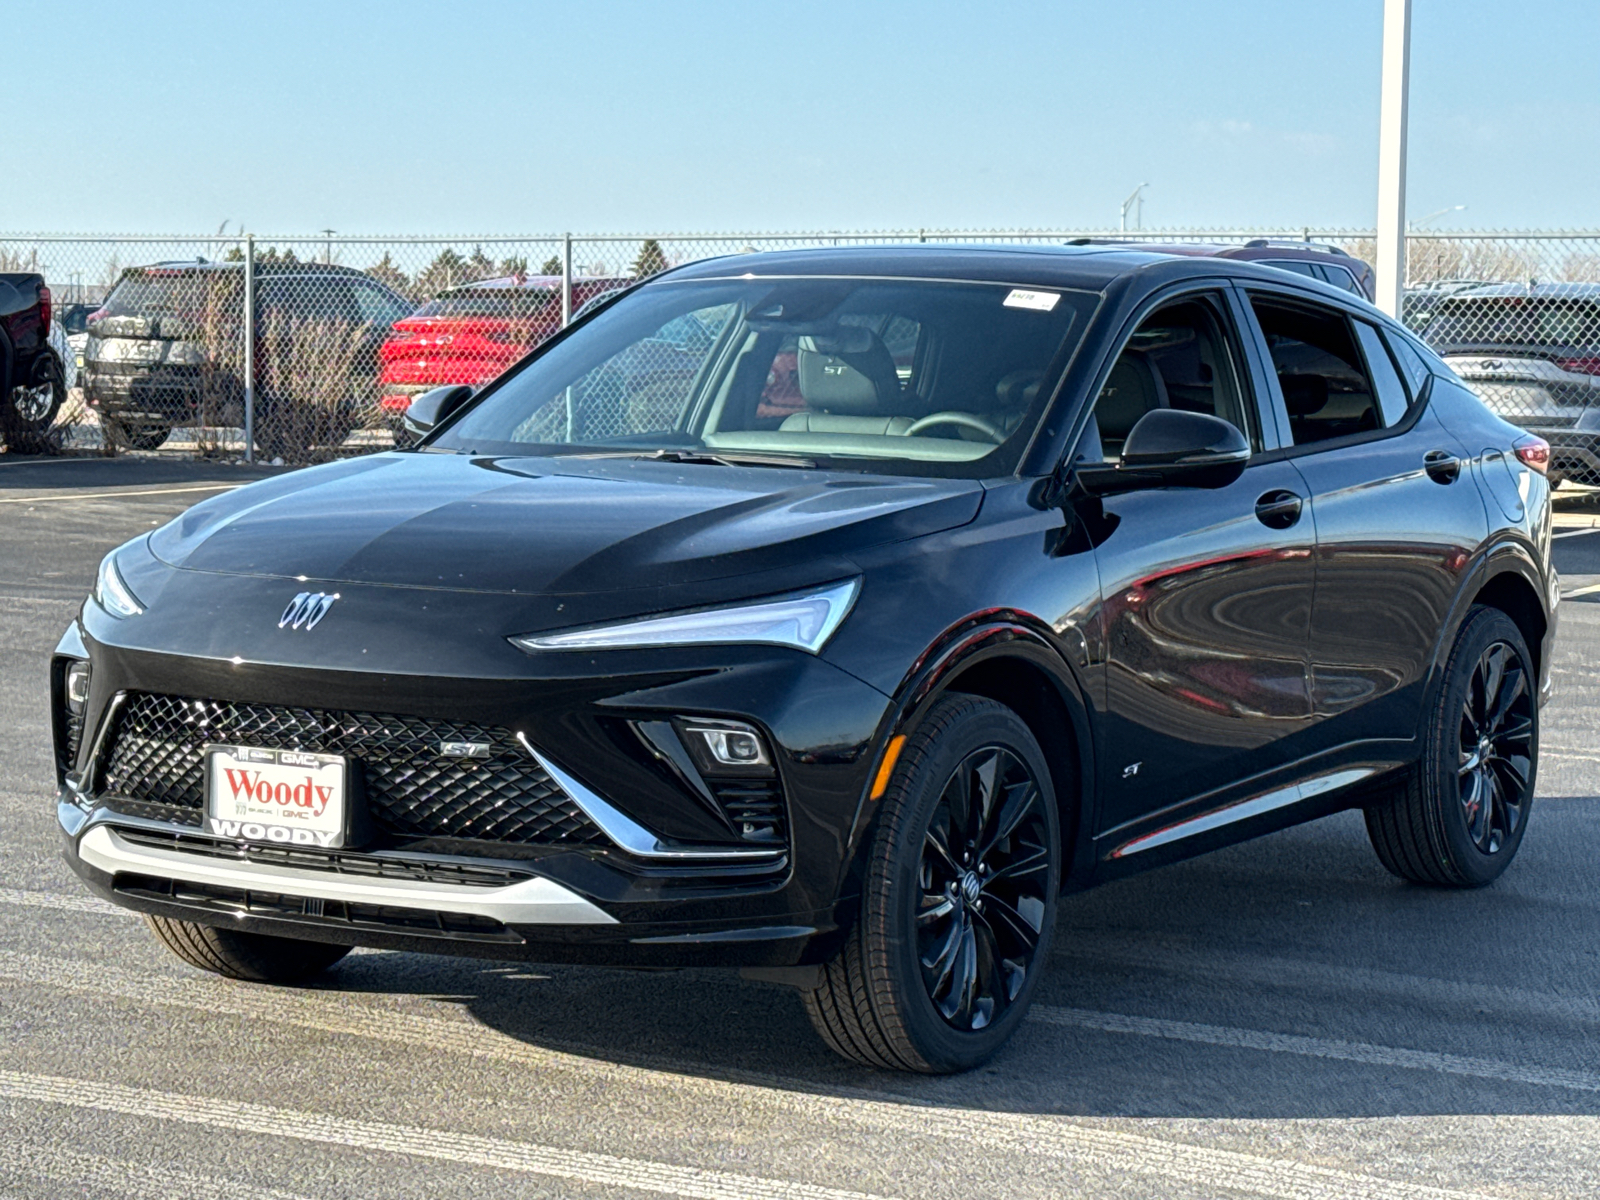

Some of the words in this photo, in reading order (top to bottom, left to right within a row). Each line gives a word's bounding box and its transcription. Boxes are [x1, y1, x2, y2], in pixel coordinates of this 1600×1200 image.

[824, 366, 848, 375] ST
[281, 753, 316, 766] GMC
[223, 768, 335, 817] Woody
[282, 809, 310, 820] GMC
[209, 818, 338, 848] WOODY
